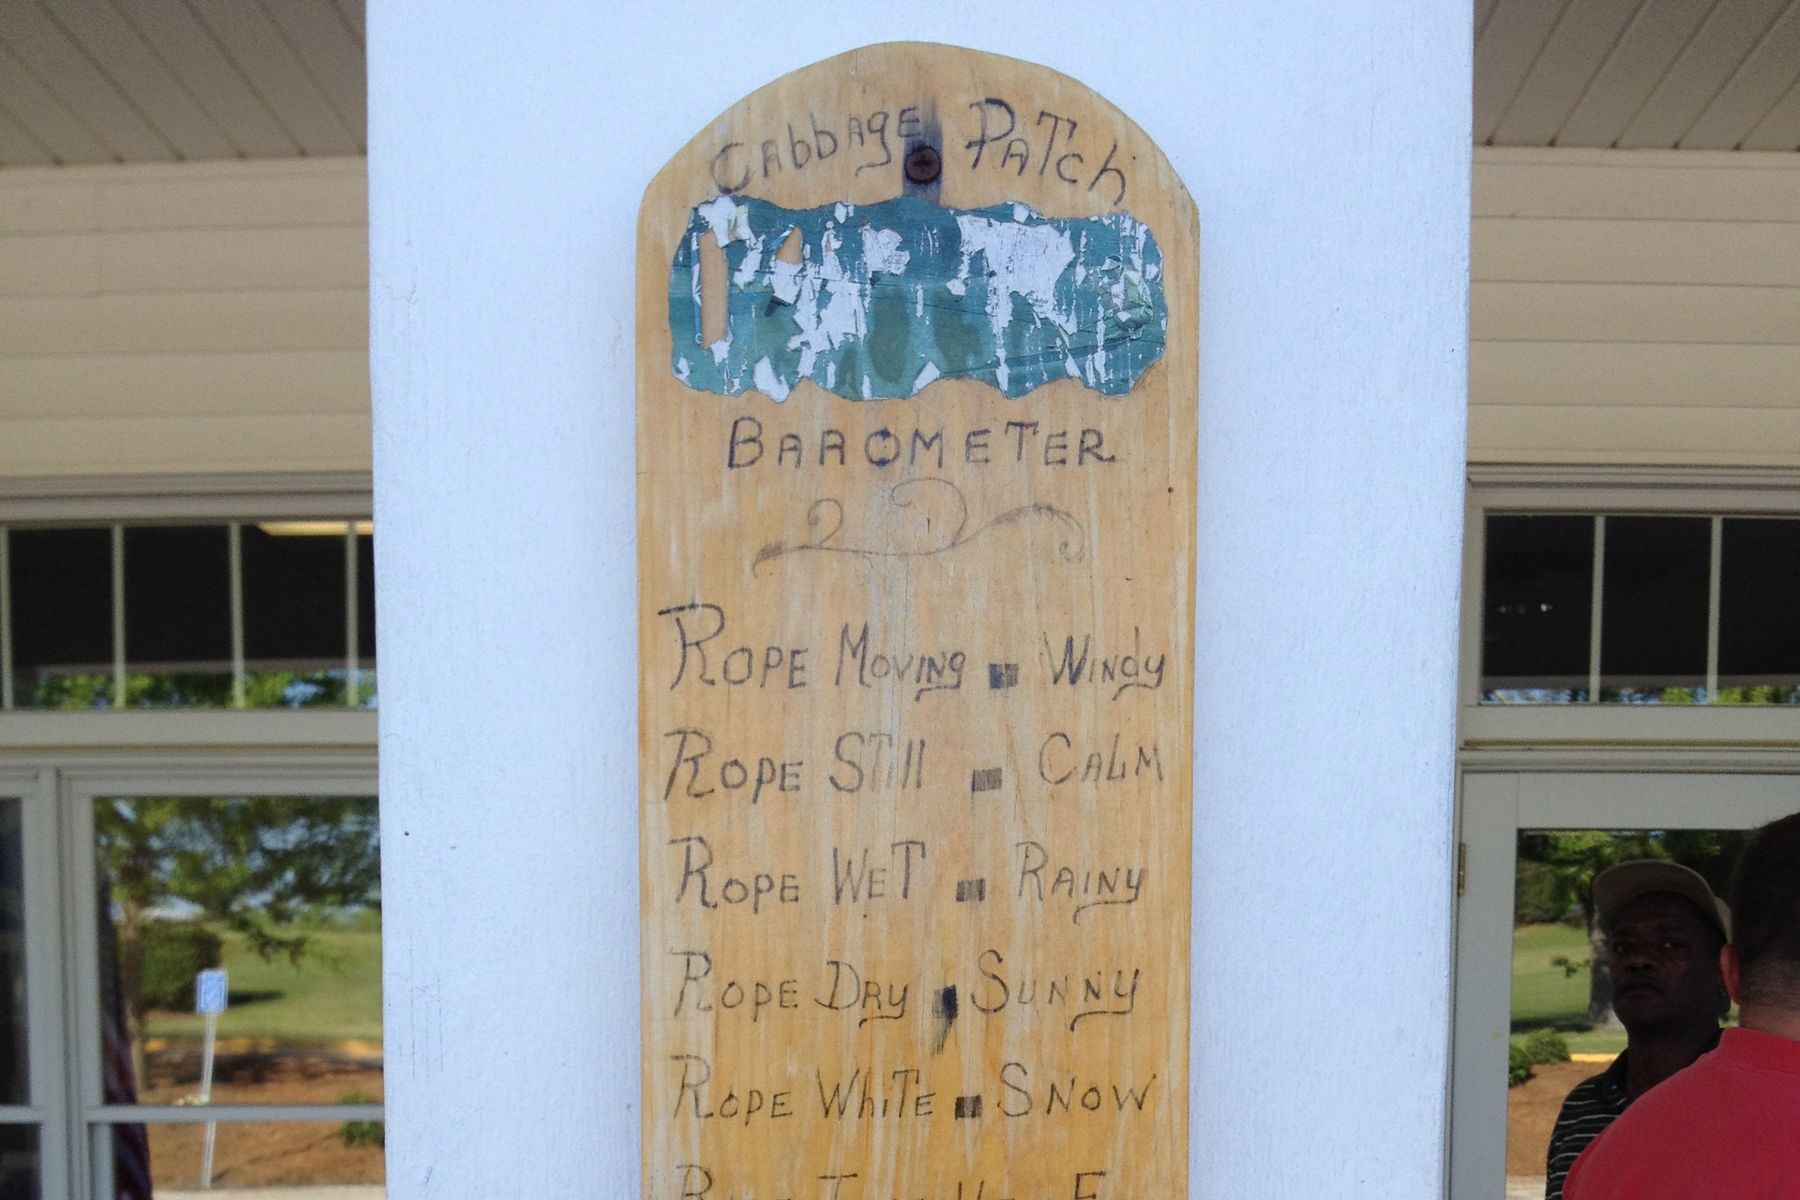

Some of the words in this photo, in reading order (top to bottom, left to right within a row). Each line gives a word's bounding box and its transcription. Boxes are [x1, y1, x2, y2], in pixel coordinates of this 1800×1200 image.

[728, 417, 1115, 469] BAROMETER
[657, 603, 809, 690] ROPE
[663, 729, 803, 804] ROPE
[1038, 732, 1164, 785] CALM
[667, 836, 799, 913] ROPE
[832, 840, 926, 905] WET
[670, 951, 798, 1021] ROPE
[670, 1055, 794, 1126] ROPE
[997, 1062, 1157, 1119] SNOW
